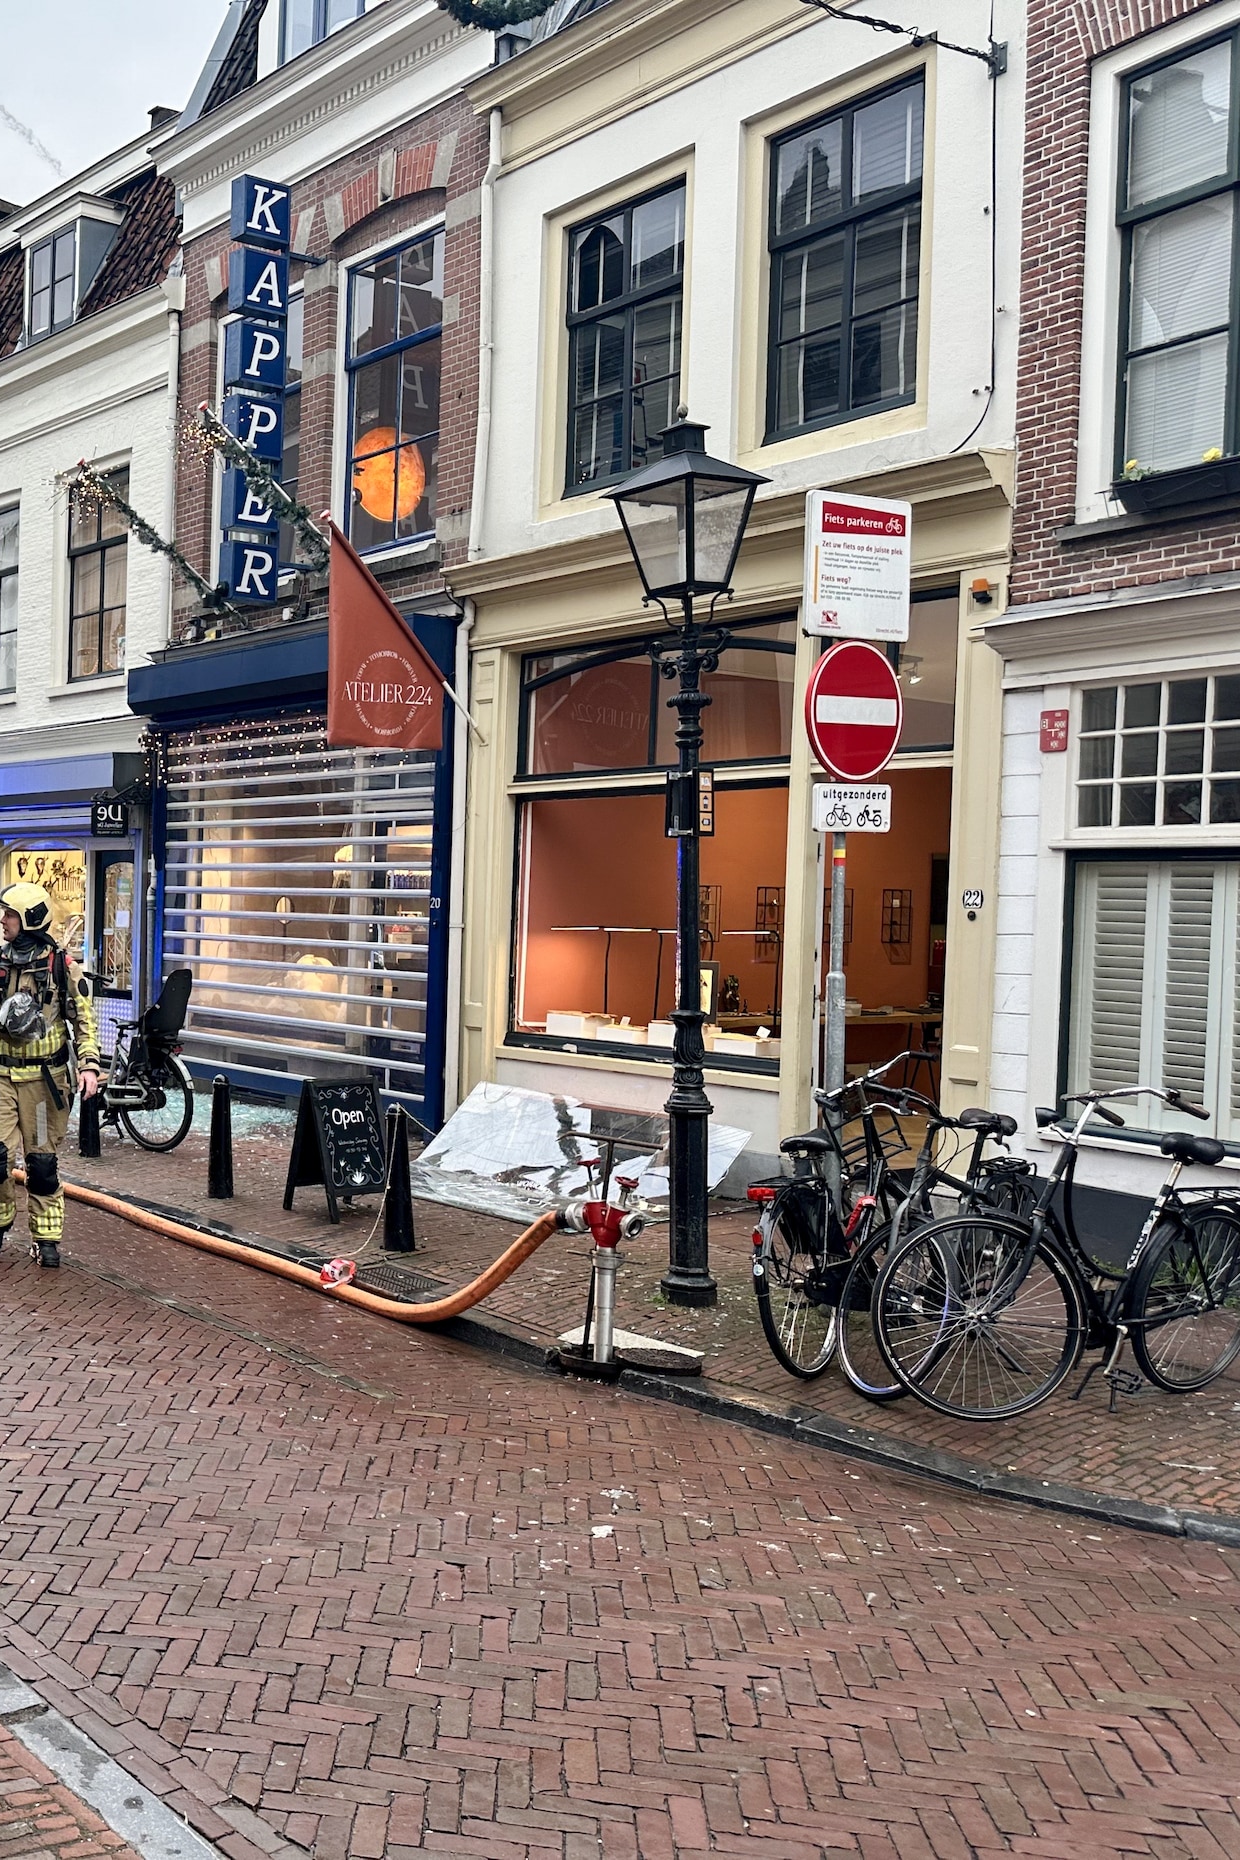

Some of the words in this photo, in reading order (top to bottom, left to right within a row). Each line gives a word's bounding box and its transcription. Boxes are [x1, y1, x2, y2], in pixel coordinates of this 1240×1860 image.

[824, 513, 844, 525] Fiets
[846, 517, 884, 530] parkeren
[843, 542, 856, 551] fiets
[874, 547, 890, 555] juiste
[821, 574, 835, 582] Fiets
[342, 681, 404, 703] ATELIER
[405, 685, 433, 706] 224
[823, 789, 887, 801] uitgezonderd
[430, 897, 441, 909] 20
[965, 890, 980, 906] 22
[331, 1107, 364, 1130] Open
